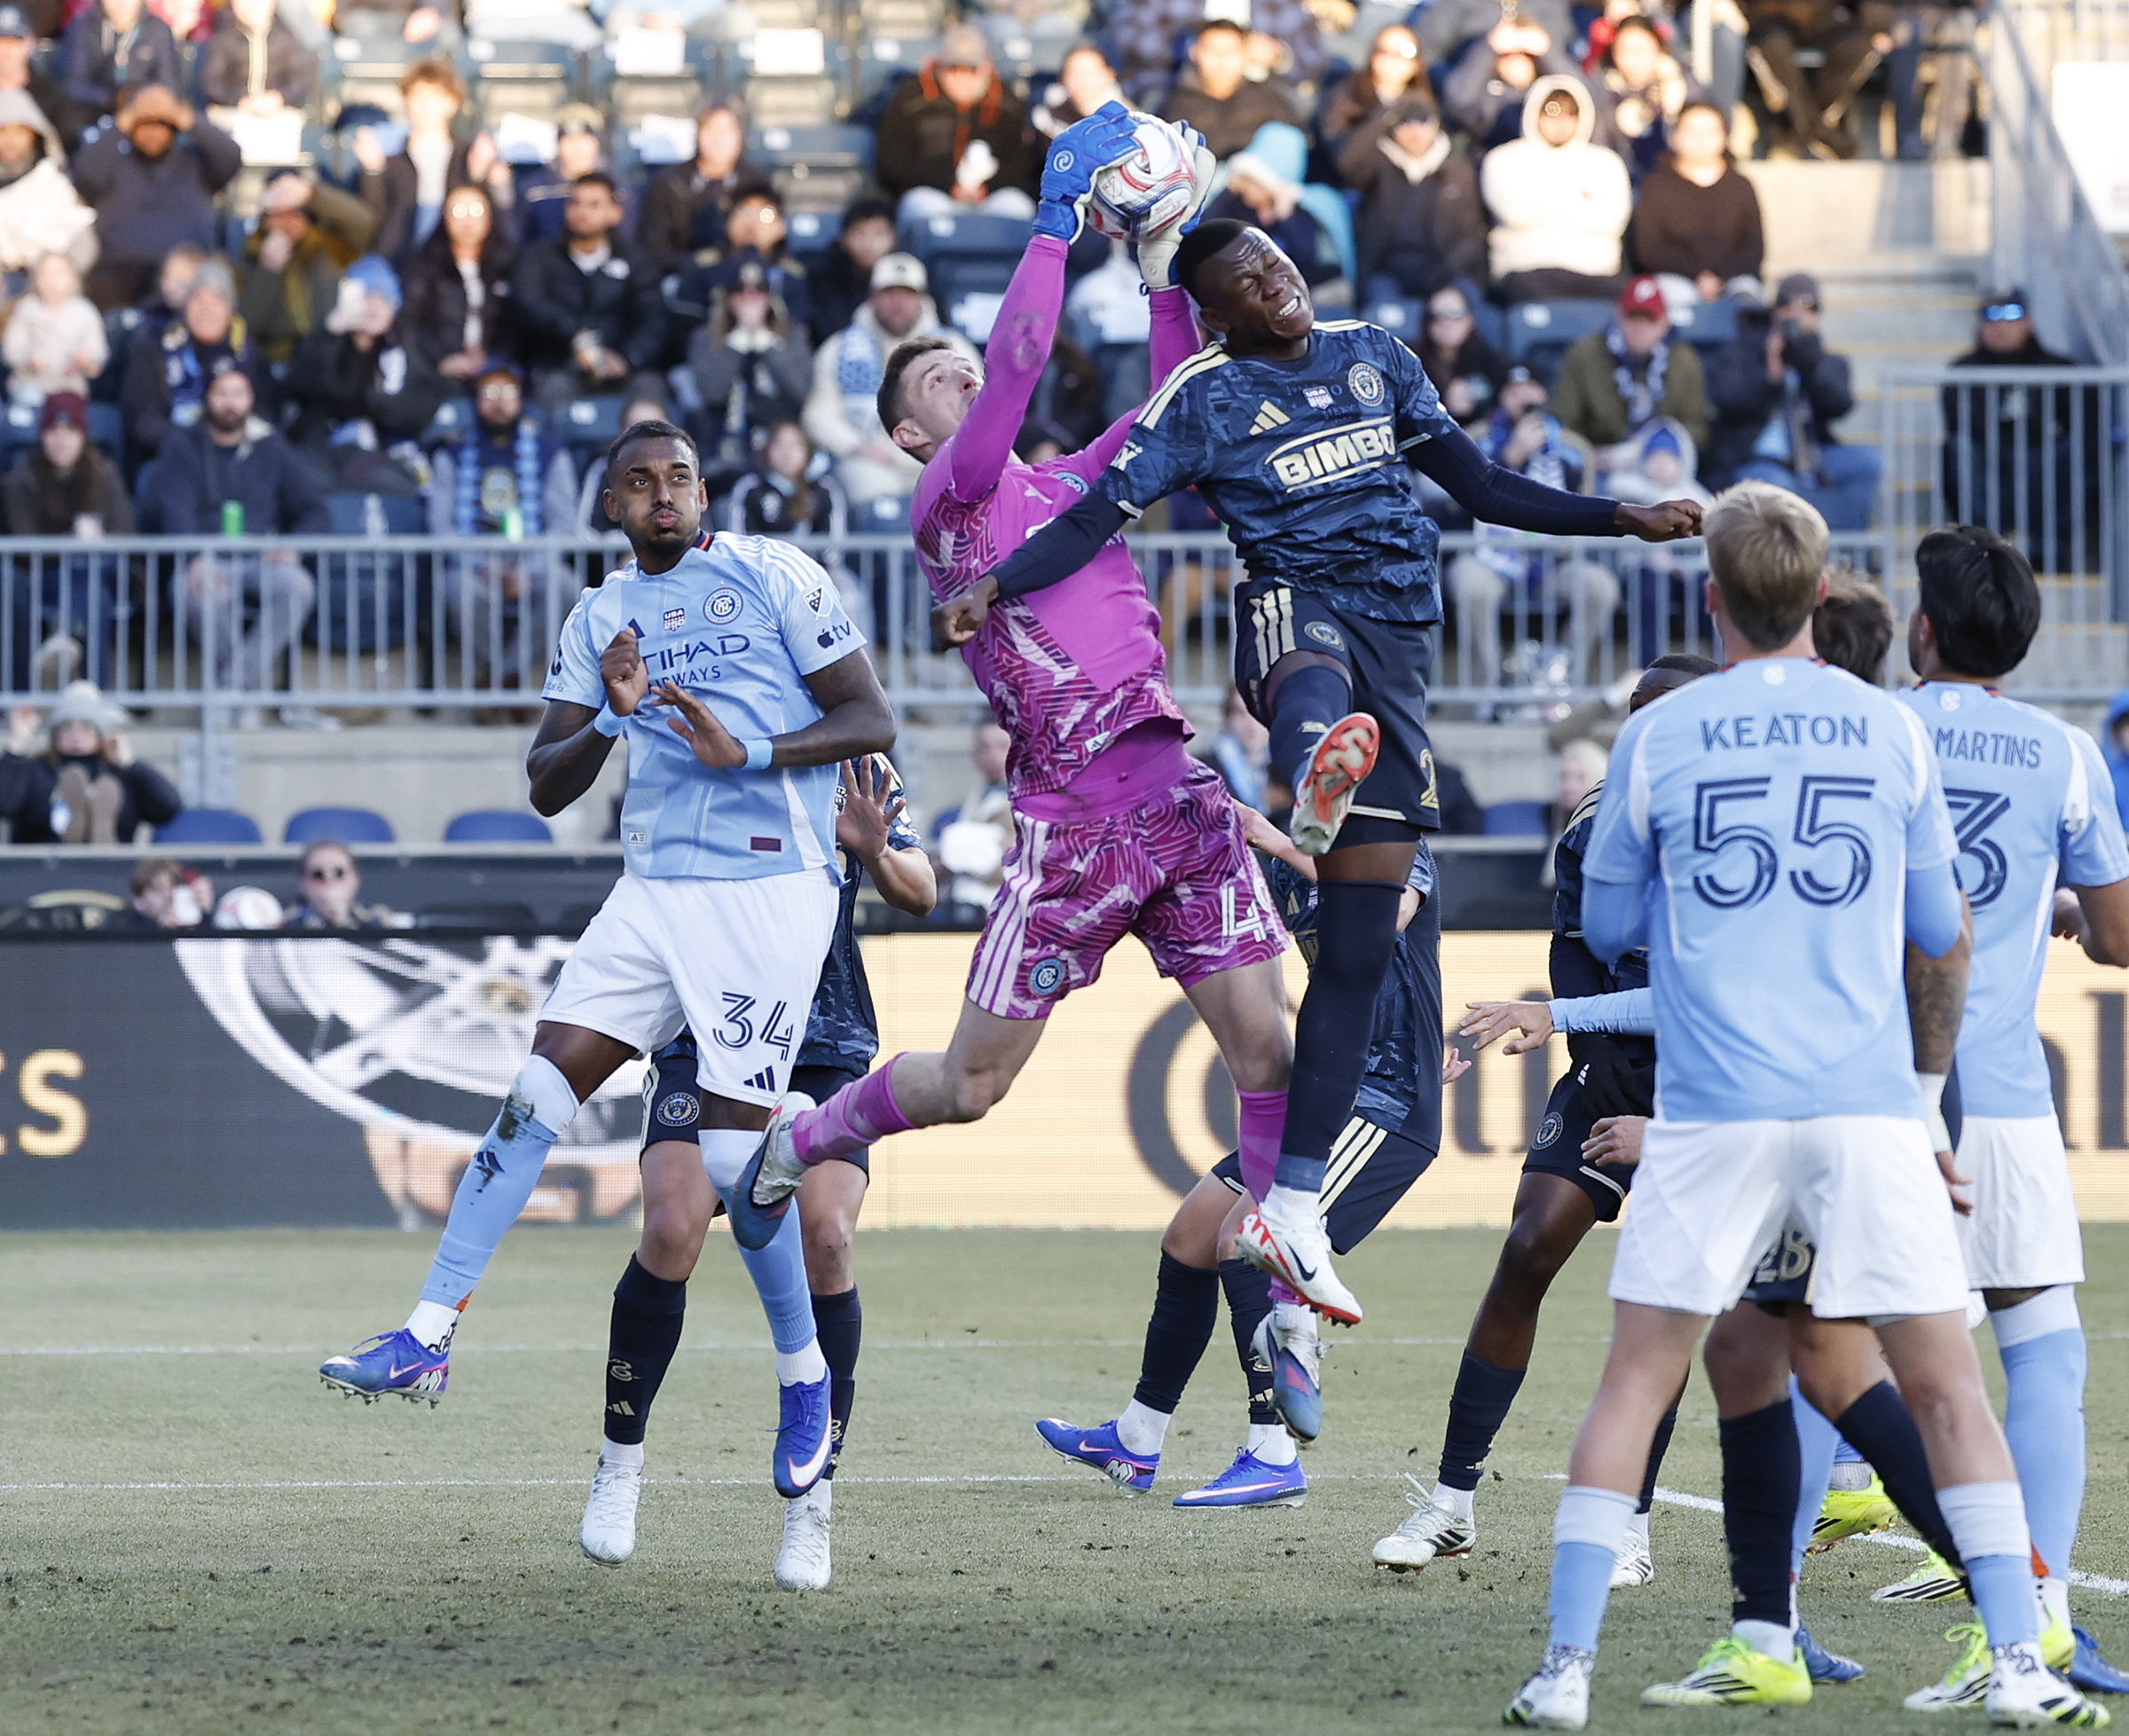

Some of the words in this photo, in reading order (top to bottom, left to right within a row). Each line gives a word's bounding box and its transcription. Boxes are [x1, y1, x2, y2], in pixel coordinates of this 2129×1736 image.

[1272, 425, 1396, 486] BIMBO
[664, 609, 685, 619] USA
[832, 621, 851, 641] tv
[641, 634, 750, 675] TIHAD
[1700, 712, 1869, 752] KEATON
[1926, 726, 2043, 769] MARTINS
[1693, 776, 1876, 911] 55
[712, 991, 794, 1062] 34
